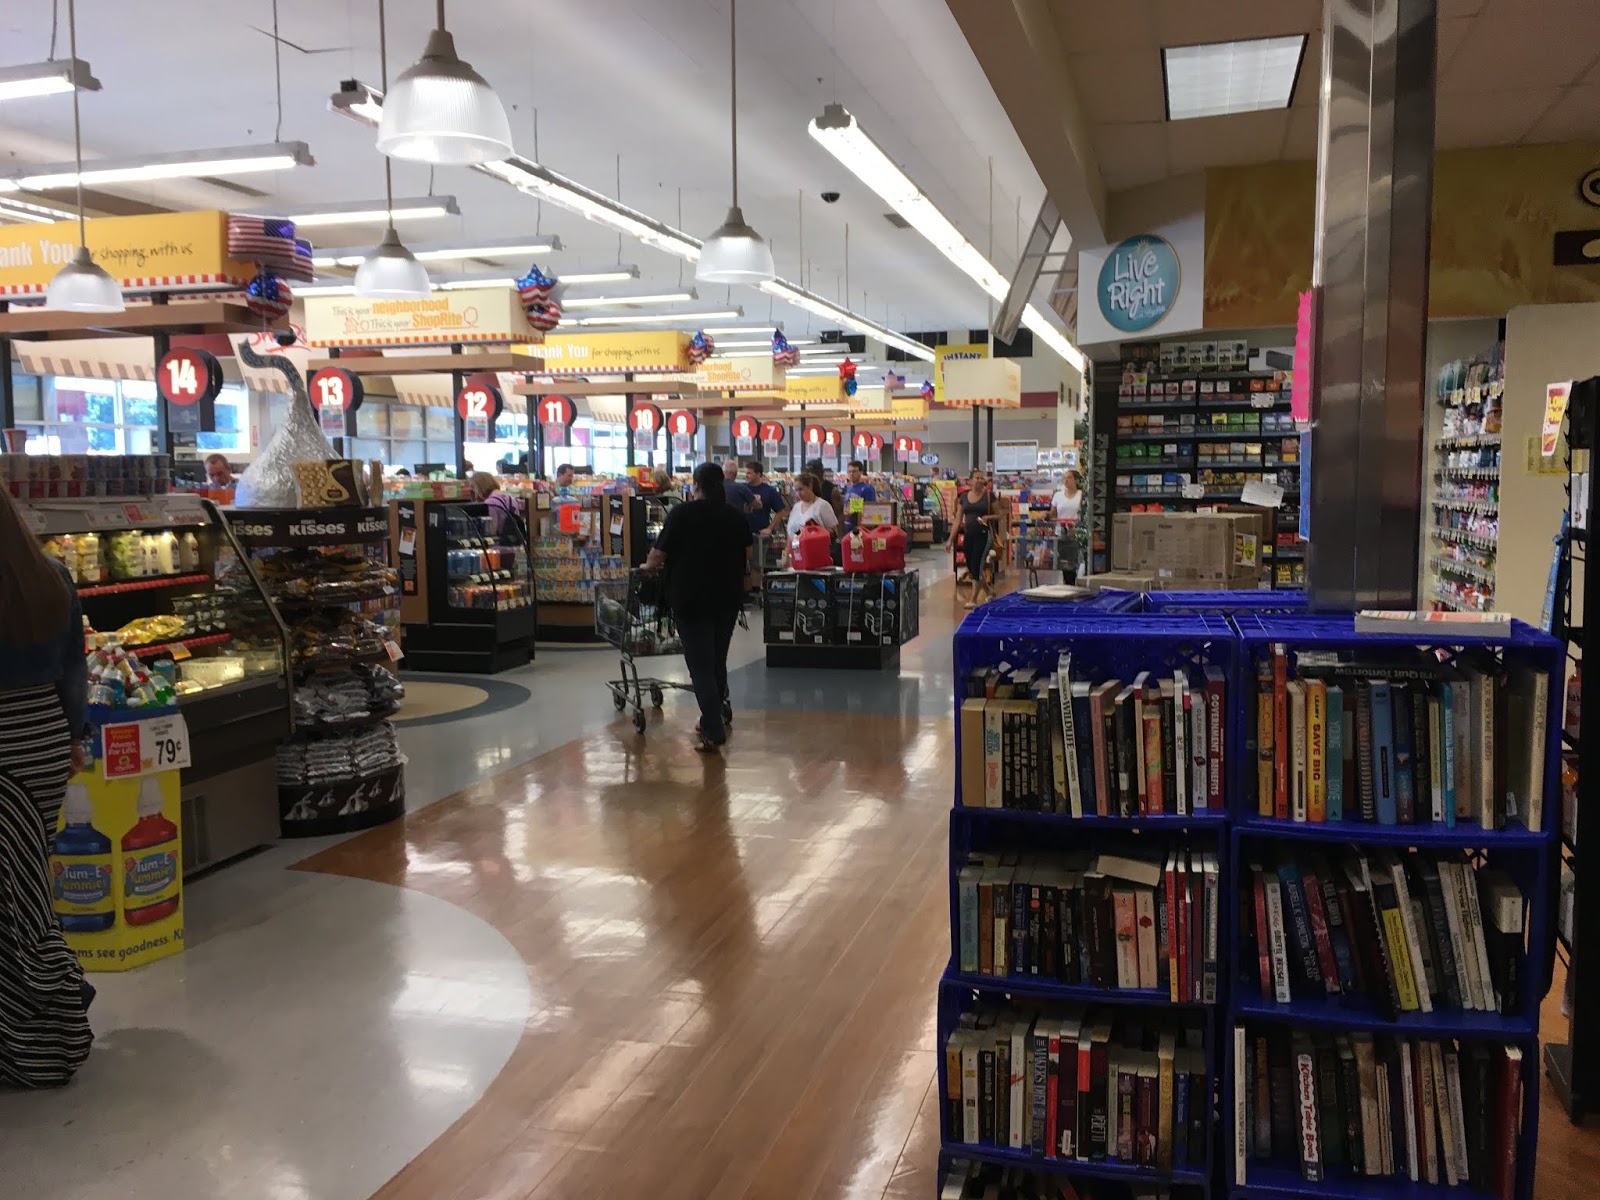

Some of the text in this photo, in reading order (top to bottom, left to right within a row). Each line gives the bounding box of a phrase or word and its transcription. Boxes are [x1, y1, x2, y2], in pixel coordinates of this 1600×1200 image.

[0, 240, 74, 268] ank You
[101, 245, 146, 267] shopping
[150, 243, 179, 257] with
[180, 242, 193, 255] us
[1114, 250, 1159, 282] Live
[332, 306, 347, 316] This
[372, 297, 449, 315] neighborhood
[1107, 278, 1165, 318] Right
[370, 318, 386, 329] This
[412, 311, 463, 329] ShopRite
[527, 344, 563, 359] Thank
[567, 343, 589, 357] You
[592, 347, 603, 361] for
[603, 348, 633, 362] shopping
[633, 346, 650, 356] with
[943, 352, 983, 361] INSTANT
[166, 358, 198, 395] 14
[707, 371, 741, 382] ShopRite
[317, 376, 343, 405] 13
[464, 391, 488, 417] 12
[545, 401, 563, 423] 11
[635, 409, 653, 430] 10
[676, 415, 687, 434] 9
[739, 420, 749, 436] 8
[766, 425, 776, 440] 7
[826, 431, 834, 445] 5
[857, 434, 865, 447] 4
[899, 438, 907, 450] 2
[1334, 667, 1391, 678] Tomorrow
[1062, 700, 1075, 749] WILDLIFE
[1210, 693, 1220, 796] GOVERNMENT BENEFITS
[1312, 724, 1321, 759] SAVE
[1312, 760, 1321, 781] BIG
[1294, 915, 1310, 948] HAMILTON
[97, 948, 115, 958] see
[1033, 1085, 1047, 1106] DIET
[1300, 1062, 1315, 1158] Kitchen Table Book
[1091, 1113, 1106, 1142] PERETTI
